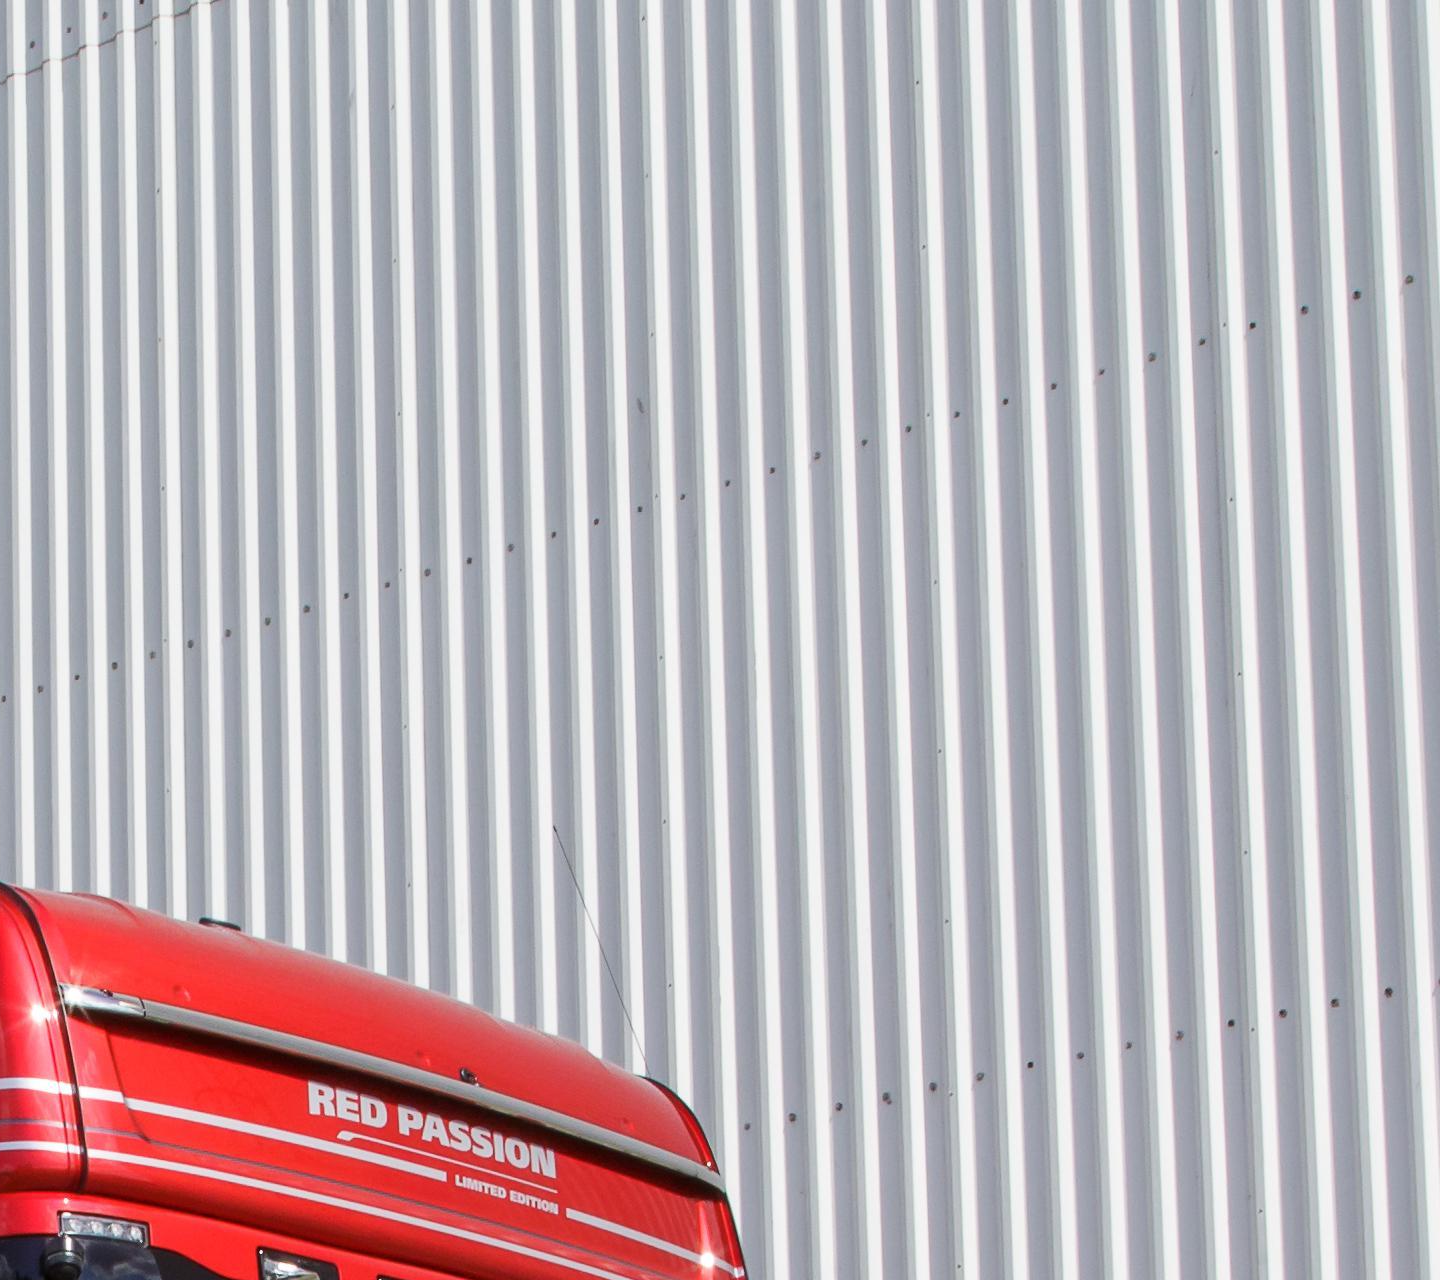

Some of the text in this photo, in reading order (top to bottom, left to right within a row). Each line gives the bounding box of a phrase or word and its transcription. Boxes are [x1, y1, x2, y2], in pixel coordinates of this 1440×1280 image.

[307, 1080, 558, 1179] RED PASSION
[455, 1174, 559, 1215] LIMITED EDITION
